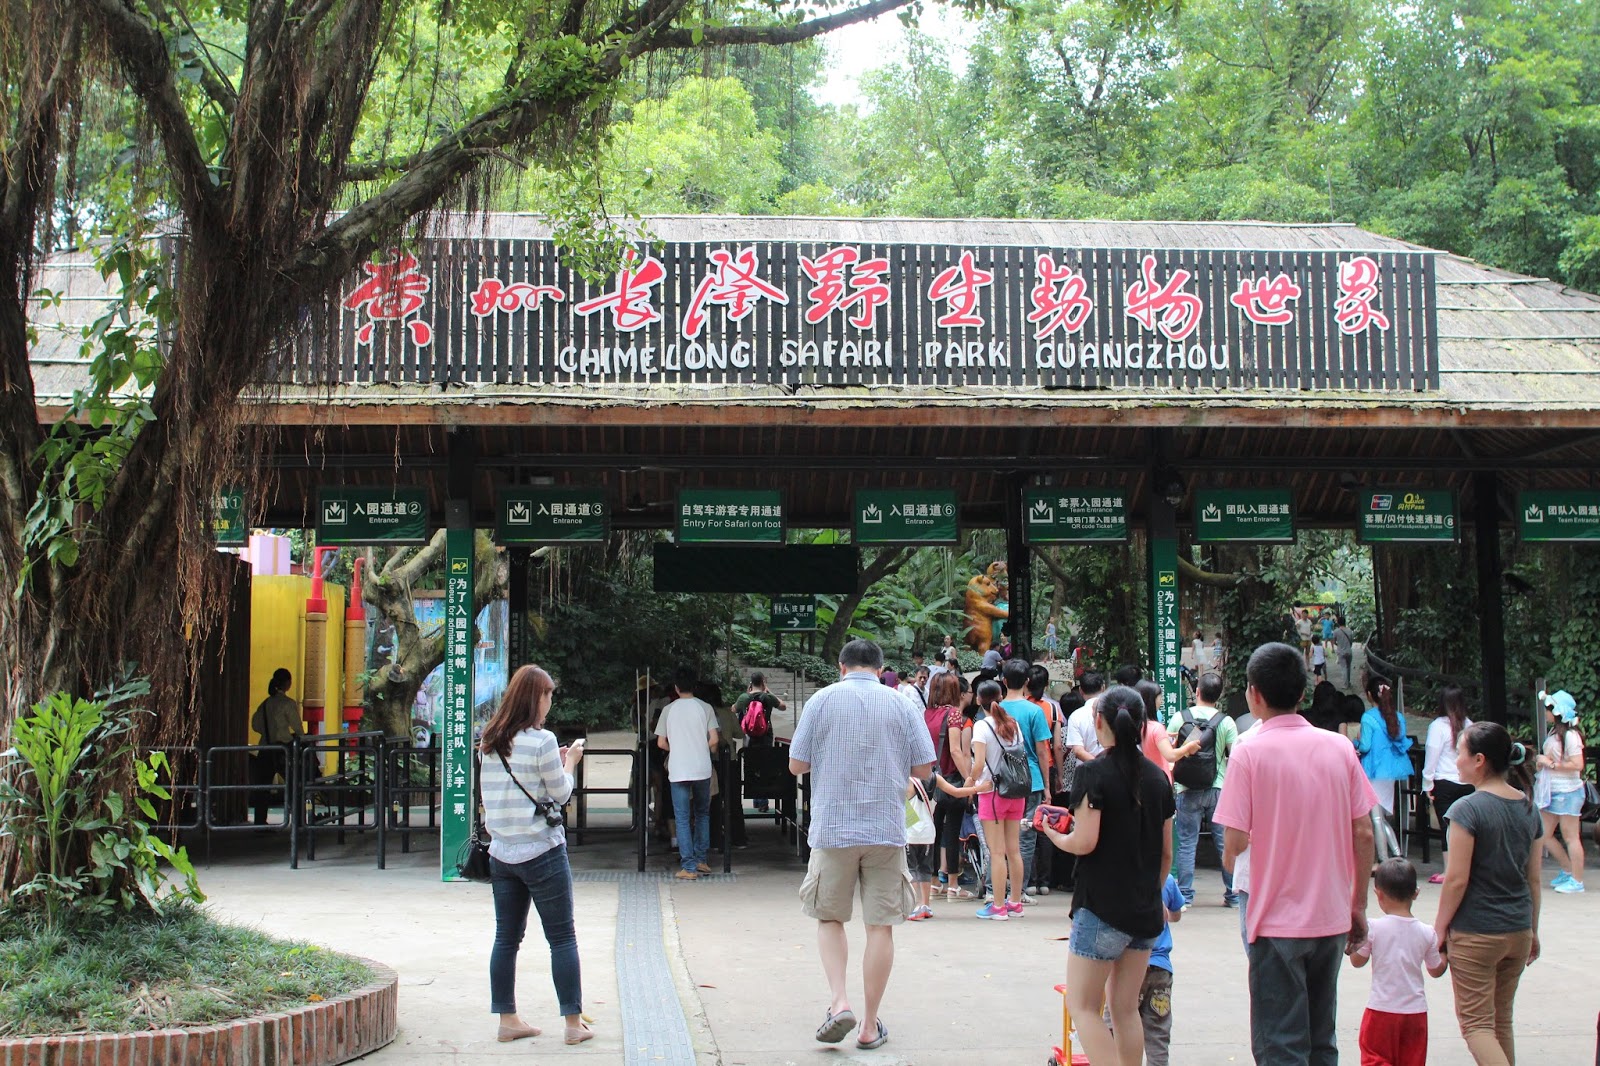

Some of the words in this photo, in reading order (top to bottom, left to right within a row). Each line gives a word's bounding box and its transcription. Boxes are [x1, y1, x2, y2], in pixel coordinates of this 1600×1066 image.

[558, 340, 751, 376] CHIMELONG
[779, 339, 893, 368] SAFARI
[925, 341, 1008, 368] PARK
[1035, 341, 1228, 371] GUANGZHOU
[1058, 497, 1123, 508] 套票入园通道
[1225, 504, 1290, 515] 团队入园通道
[682, 504, 782, 517] 自驾车游客专用通道
[1547, 505, 1600, 516] 团队入园通
[368, 517, 399, 525] Entrance
[552, 517, 583, 525] Entrance
[683, 519, 706, 529] Entry
[708, 519, 722, 527] For
[724, 519, 750, 528] Safari
[764, 520, 782, 528] foot
[448, 578, 456, 604] Queue
[448, 605, 456, 617] for
[447, 617, 456, 657] admission
[1157, 628, 1165, 666] admission
[447, 657, 455, 673] and
[1158, 667, 1166, 683] and
[446, 675, 455, 704] present
[445, 706, 454, 721] you
[446, 739, 454, 760] ticket
